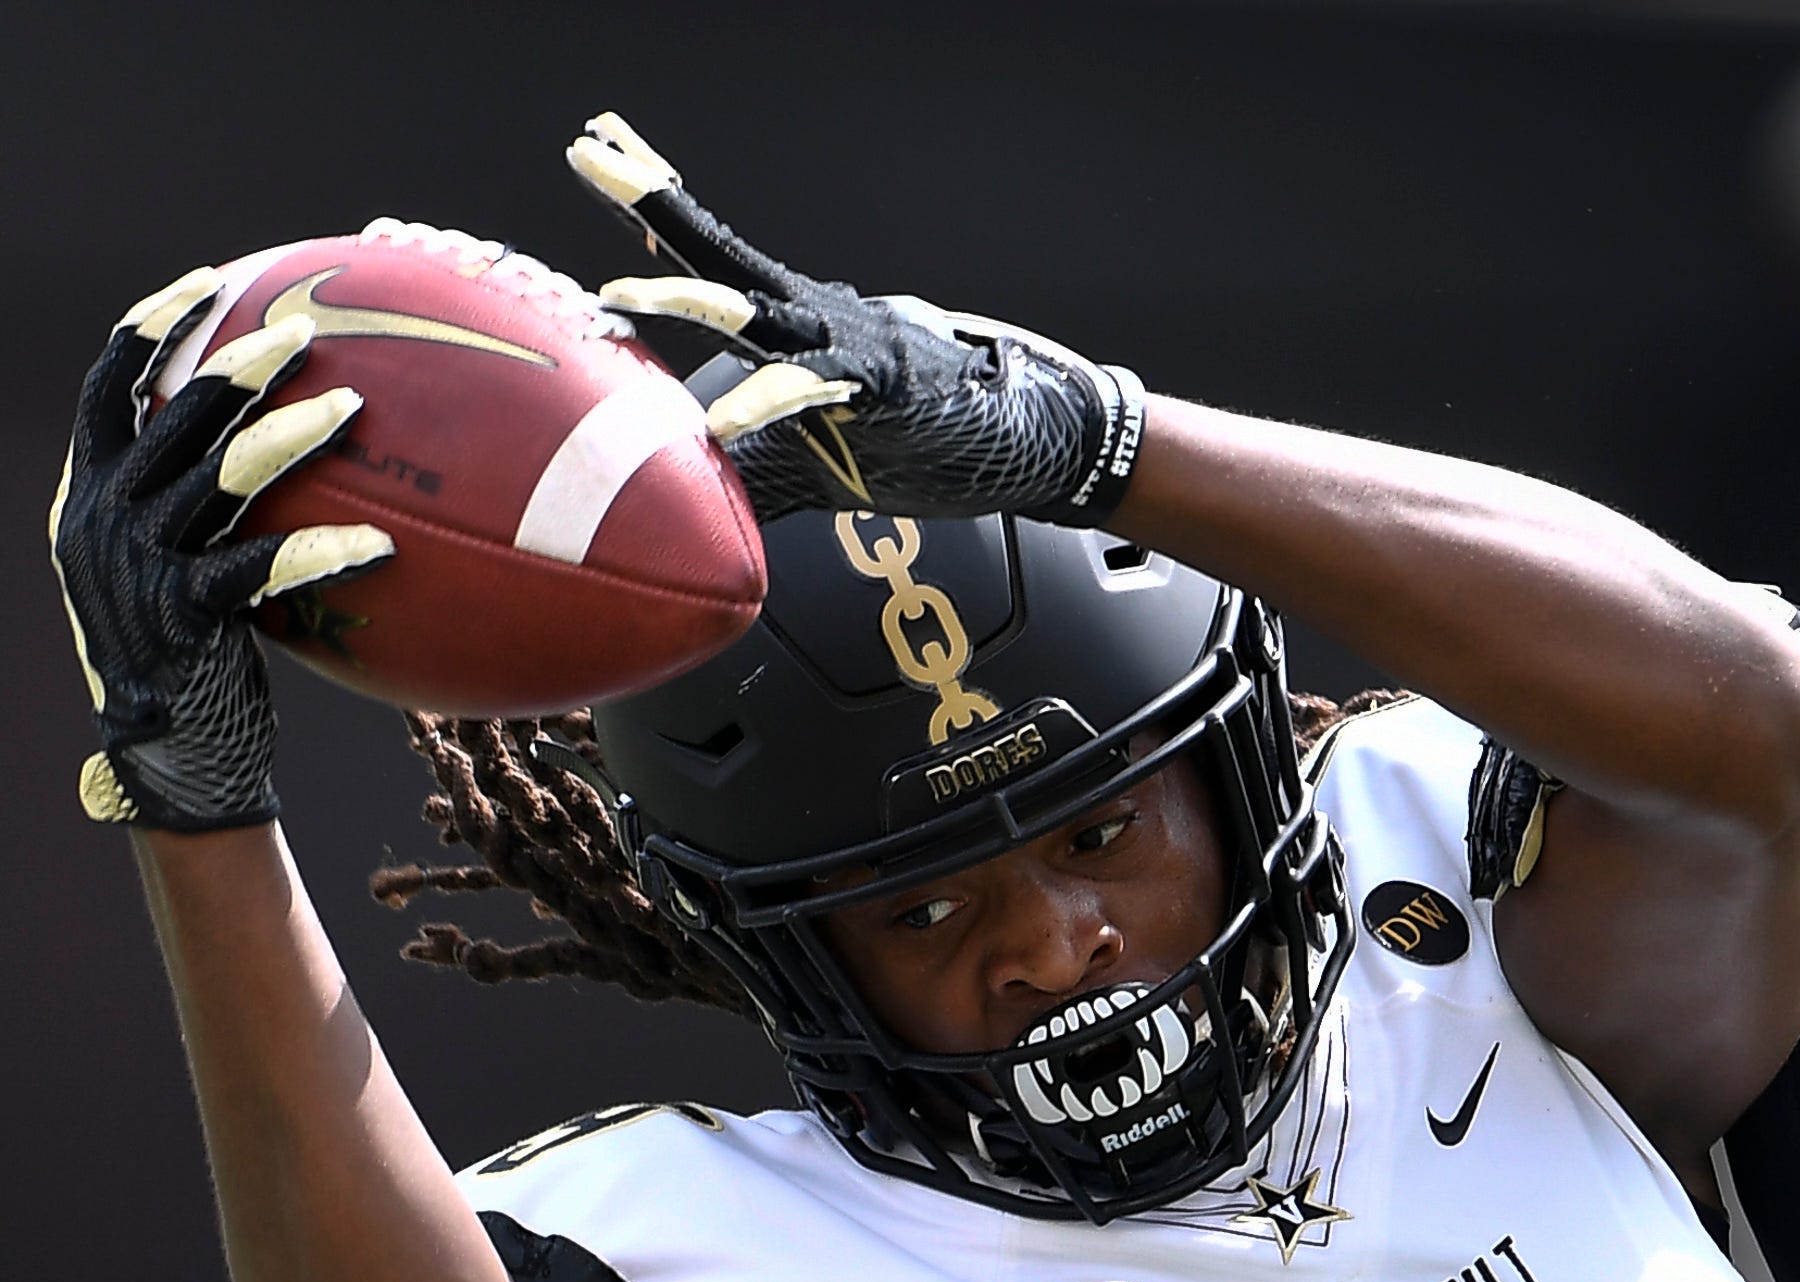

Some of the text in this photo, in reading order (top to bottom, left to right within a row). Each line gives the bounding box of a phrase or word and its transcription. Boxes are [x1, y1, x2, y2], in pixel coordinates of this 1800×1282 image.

[924, 722, 1048, 804] DORES
[1376, 891, 1450, 952] DW
[1267, 1194, 1305, 1225] V
